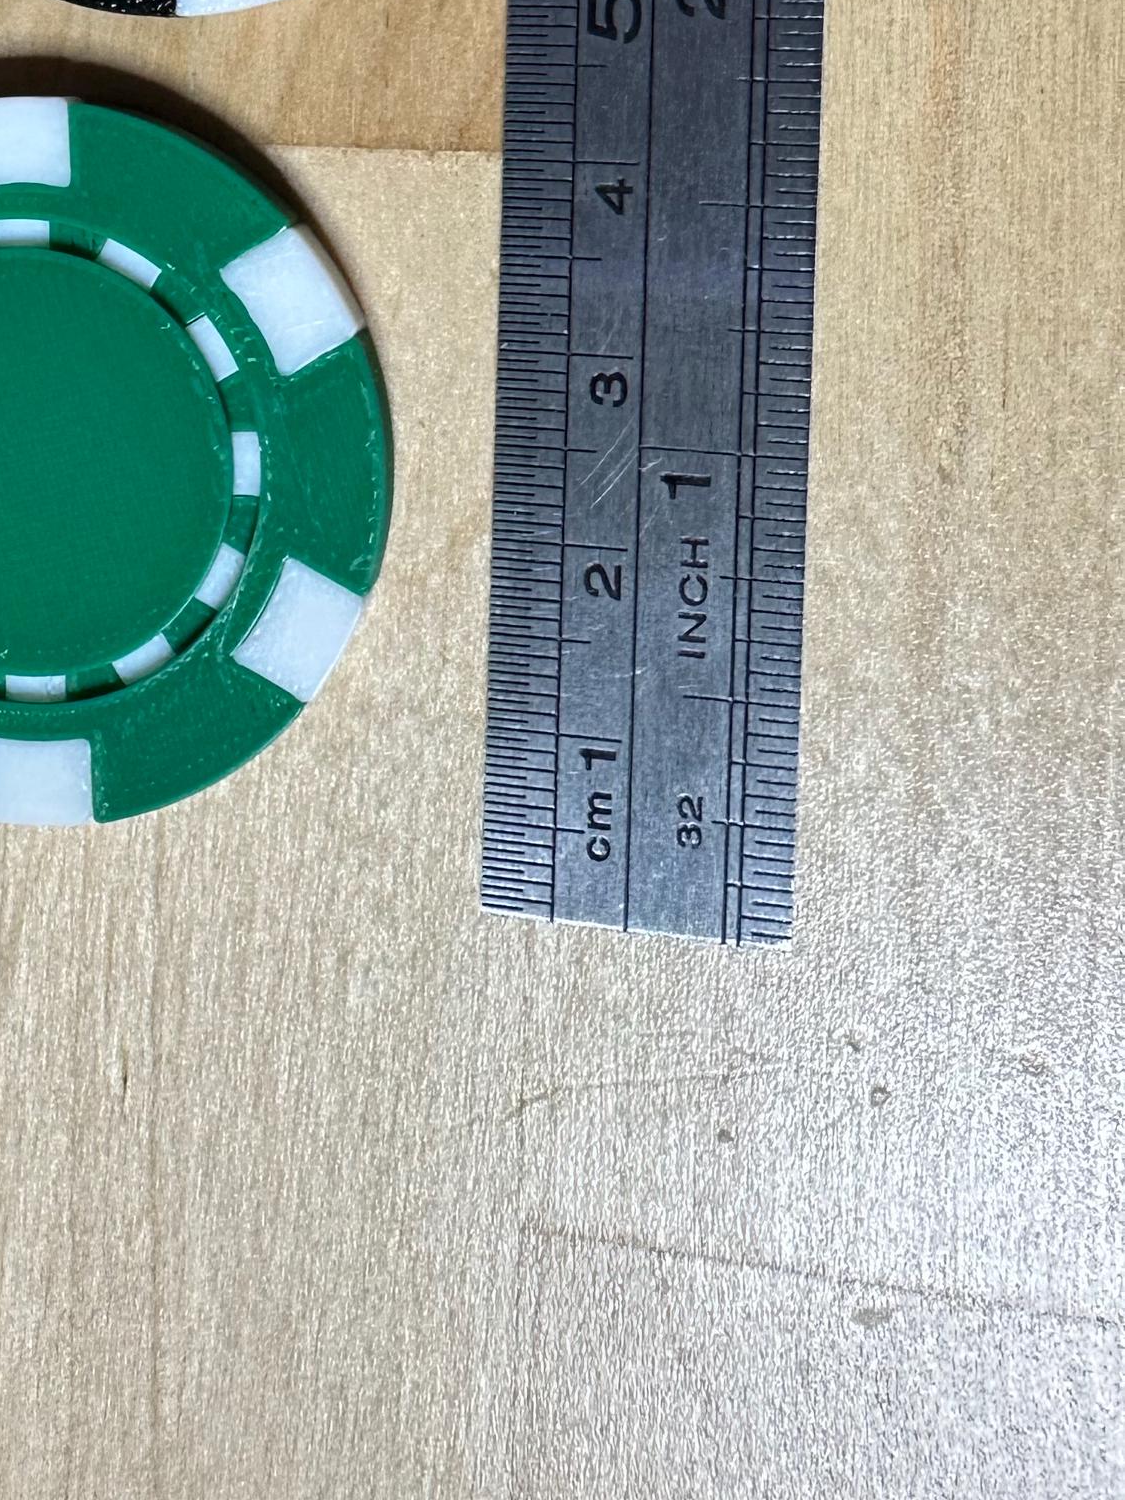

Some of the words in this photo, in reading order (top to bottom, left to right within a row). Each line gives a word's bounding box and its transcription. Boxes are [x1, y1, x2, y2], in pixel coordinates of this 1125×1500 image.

[595, 178, 633, 216] 4
[589, 371, 628, 407] 3
[660, 472, 711, 499] 1
[583, 562, 622, 601] 2
[677, 536, 710, 659] INCH
[580, 748, 617, 771] 1
[586, 791, 612, 862] cm
[676, 793, 704, 849] 32
